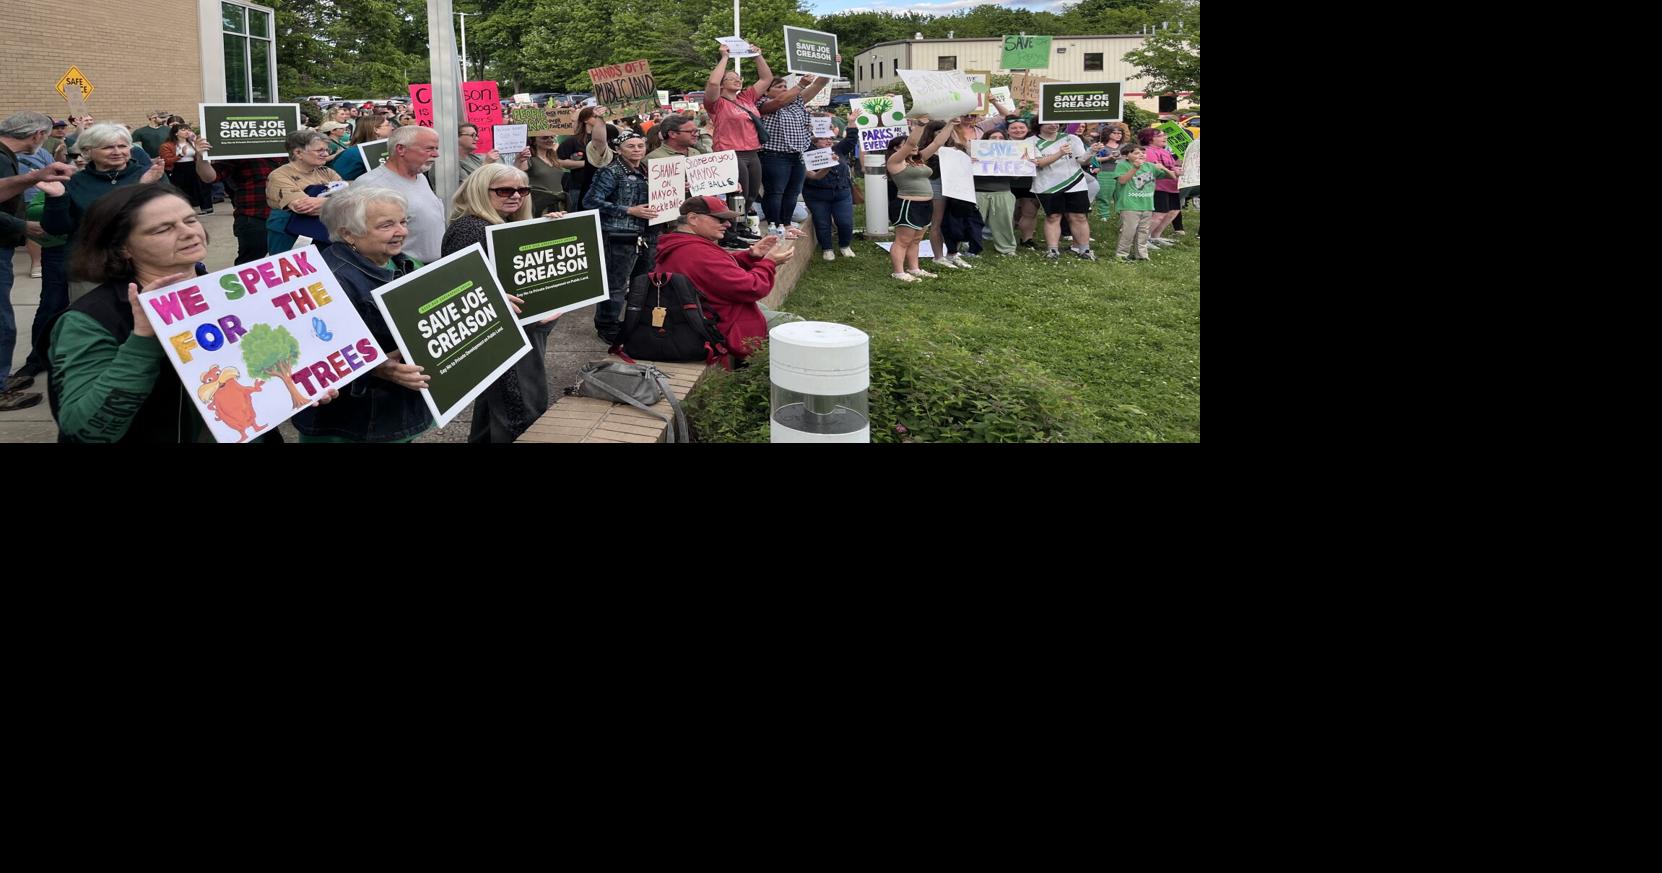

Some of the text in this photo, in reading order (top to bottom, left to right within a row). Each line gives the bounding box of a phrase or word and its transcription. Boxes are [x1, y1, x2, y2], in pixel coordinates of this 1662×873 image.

[796, 42, 830, 53] SAVE JOE
[1005, 36, 1034, 51] SAVE
[796, 50, 831, 60] CREASON
[590, 61, 646, 81] HANDS OFF
[595, 74, 655, 105] PUBLIC LAND
[1054, 93, 1109, 102] SAVE JOE
[468, 103, 498, 115] Dogs
[1053, 100, 1110, 108] CREASON
[220, 120, 285, 129] SAVE JOE
[220, 129, 287, 138] CREASON
[861, 128, 894, 141] PARKS
[651, 162, 681, 180] SHAME
[689, 166, 720, 183] MAYOR
[651, 187, 678, 201] MAYOR
[513, 249, 555, 270] SAVE
[557, 242, 586, 260] JOE
[513, 257, 588, 286] CREASON
[149, 251, 317, 325] WE SPEAK
[417, 302, 461, 339] SAVE
[461, 286, 489, 314] JOE
[169, 281, 333, 364] FOR THE
[427, 303, 498, 359] CREASON
[292, 338, 378, 396] TREES
